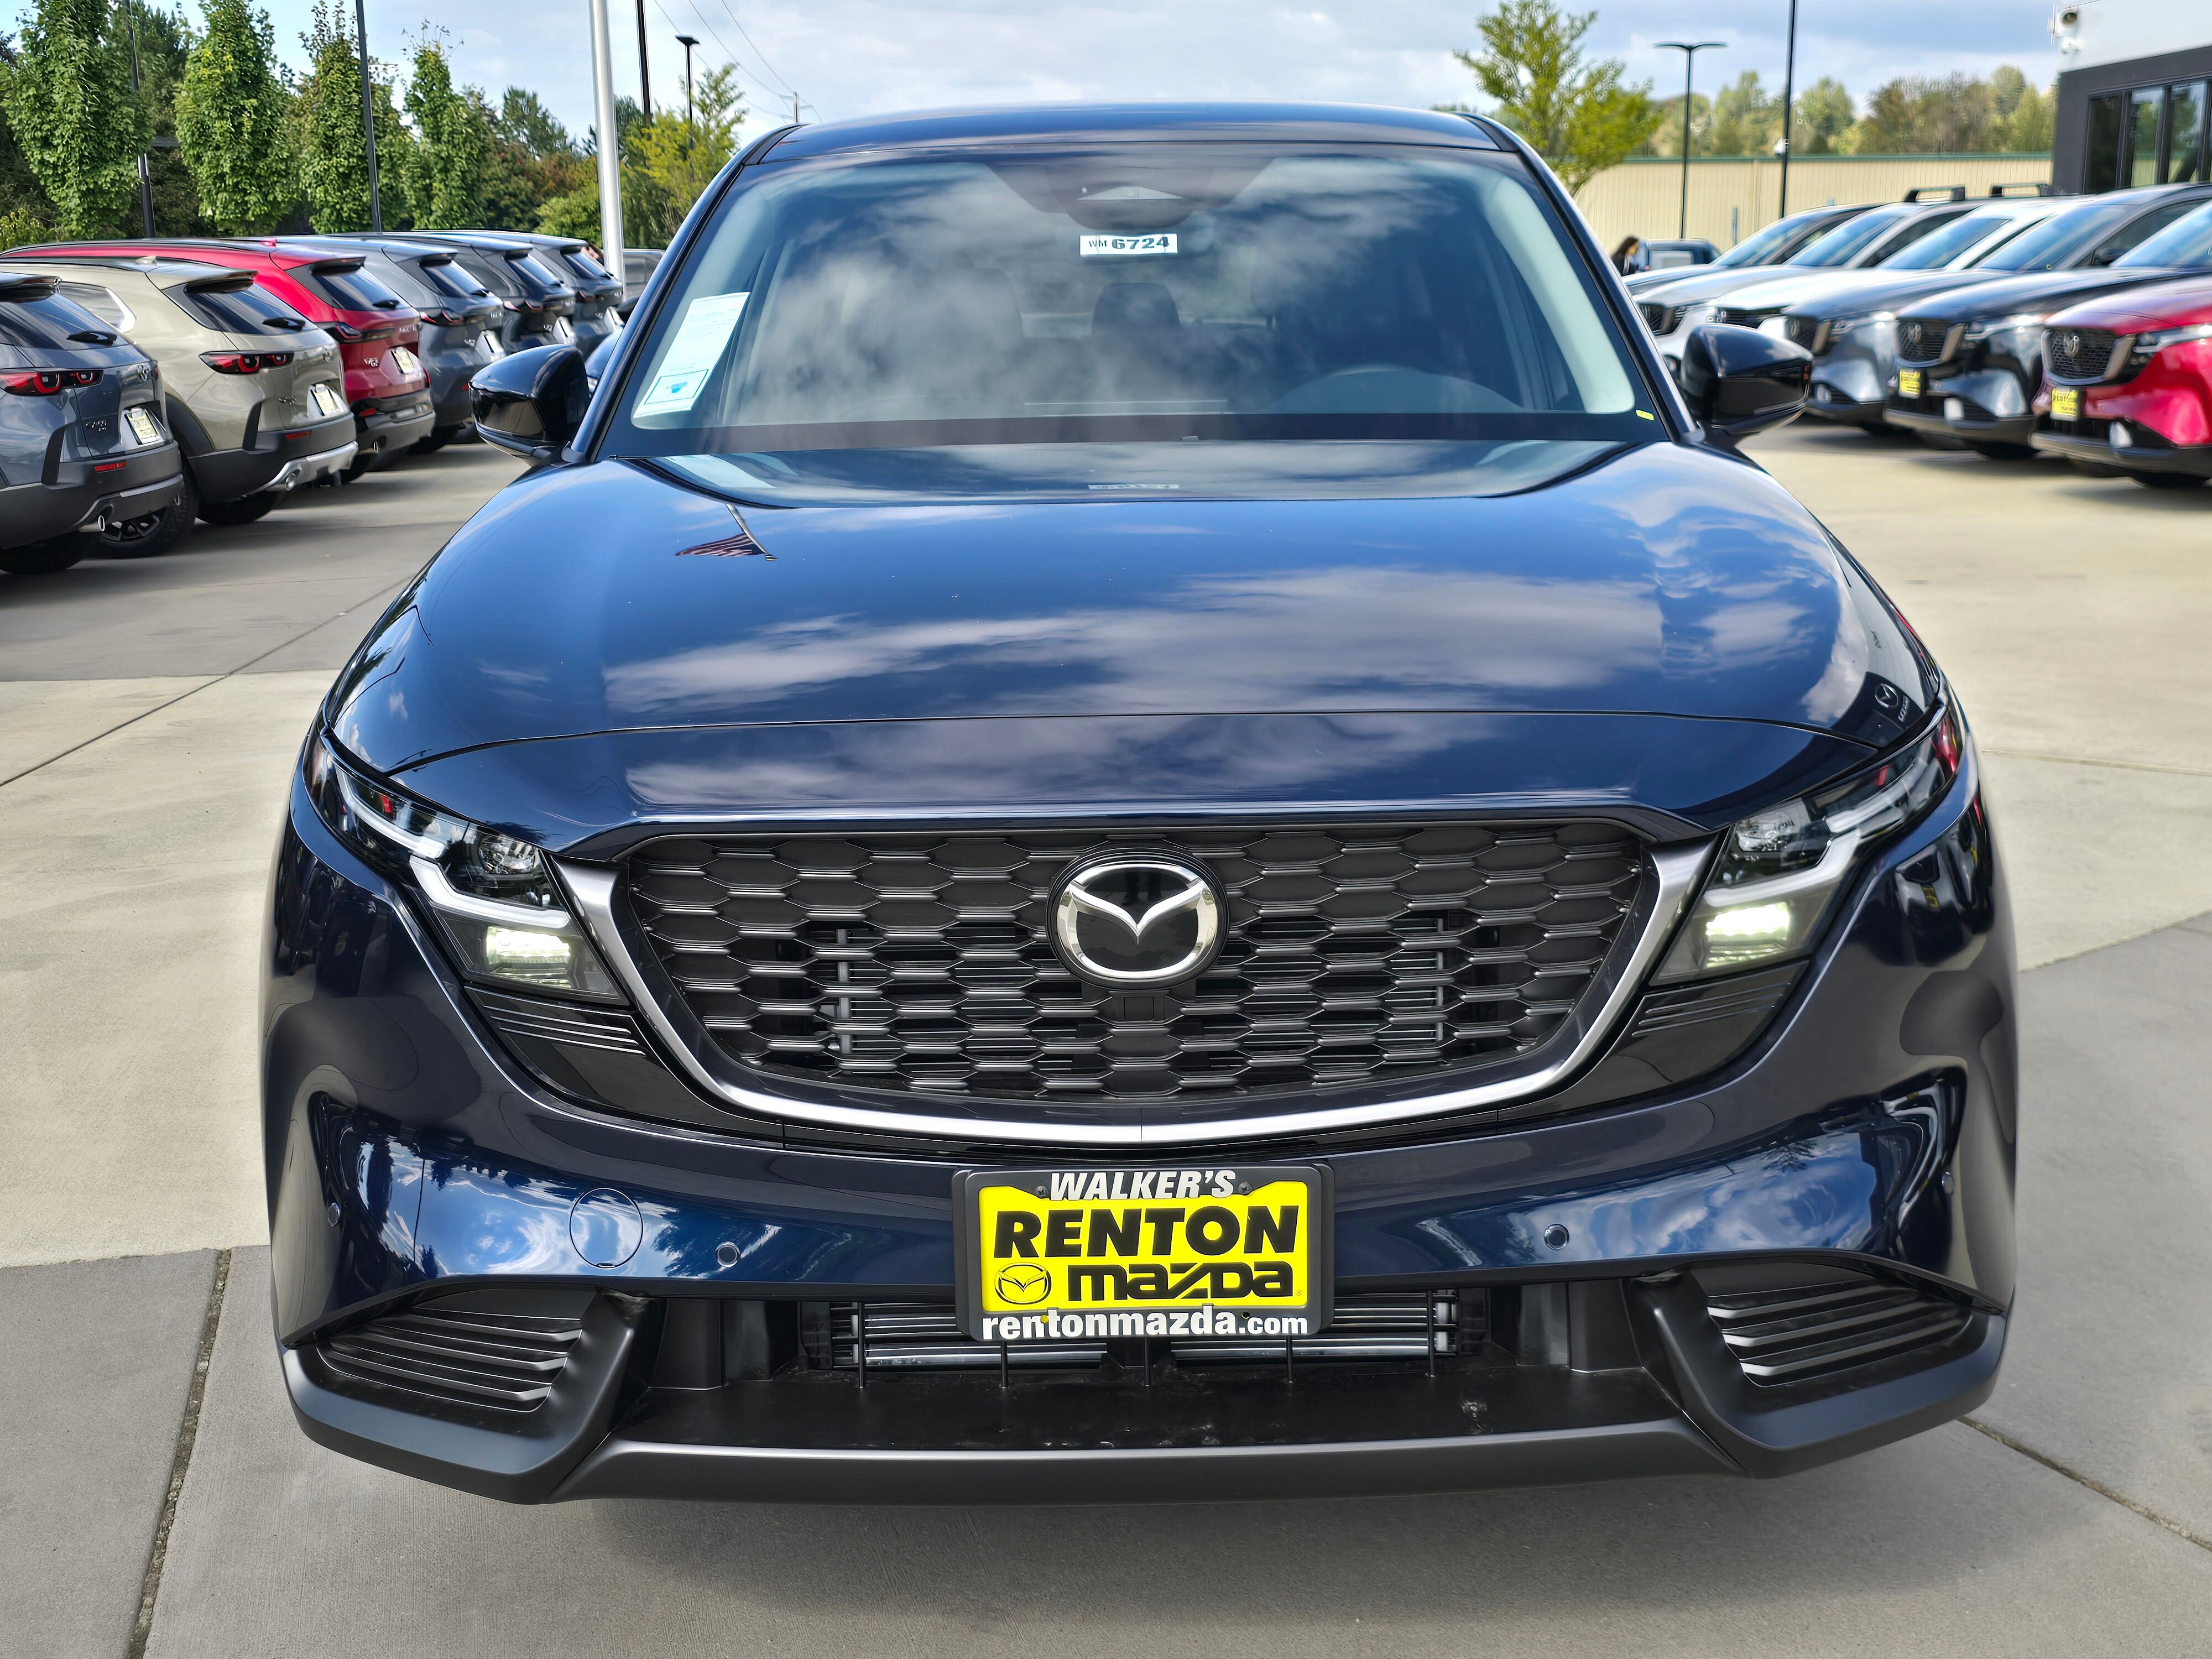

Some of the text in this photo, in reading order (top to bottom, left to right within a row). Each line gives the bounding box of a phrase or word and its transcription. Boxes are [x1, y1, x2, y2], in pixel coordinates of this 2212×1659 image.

[1112, 237, 1170, 249] 6724
[1050, 1170, 1235, 1201] WALKER'S
[993, 1204, 1299, 1258] RENTON
[982, 1305, 1308, 1340] rentonmazda.com
